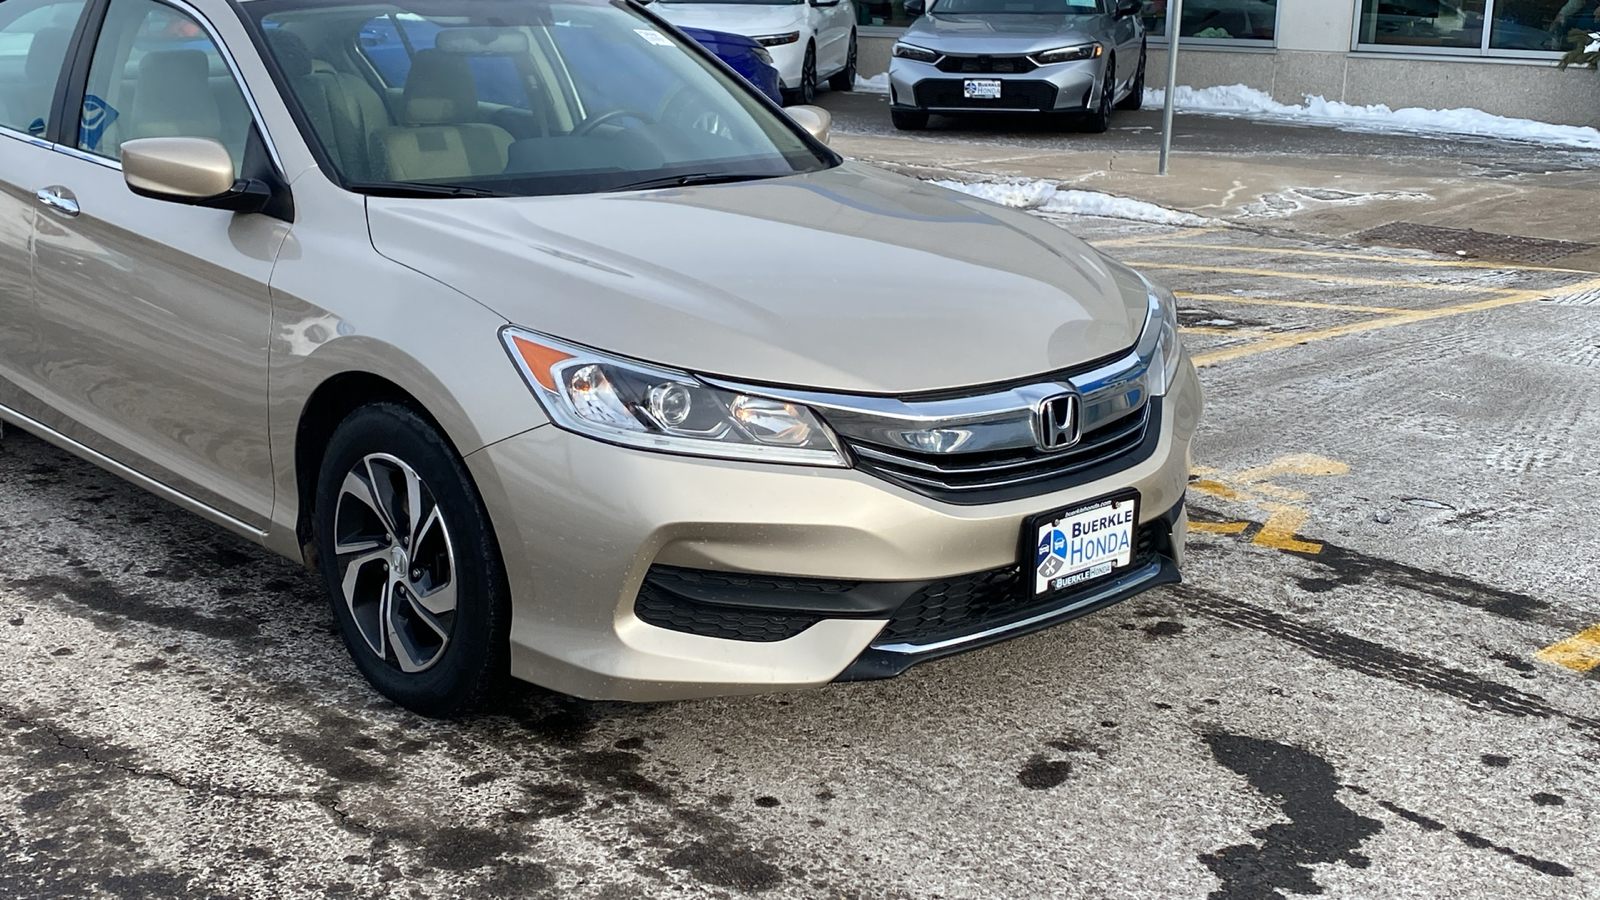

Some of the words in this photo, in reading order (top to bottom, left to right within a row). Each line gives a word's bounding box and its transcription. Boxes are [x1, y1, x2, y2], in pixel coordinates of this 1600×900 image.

[1072, 510, 1132, 538] BUERKLE
[1070, 529, 1129, 565] HONDA
[1056, 571, 1090, 588] BUERKLE
